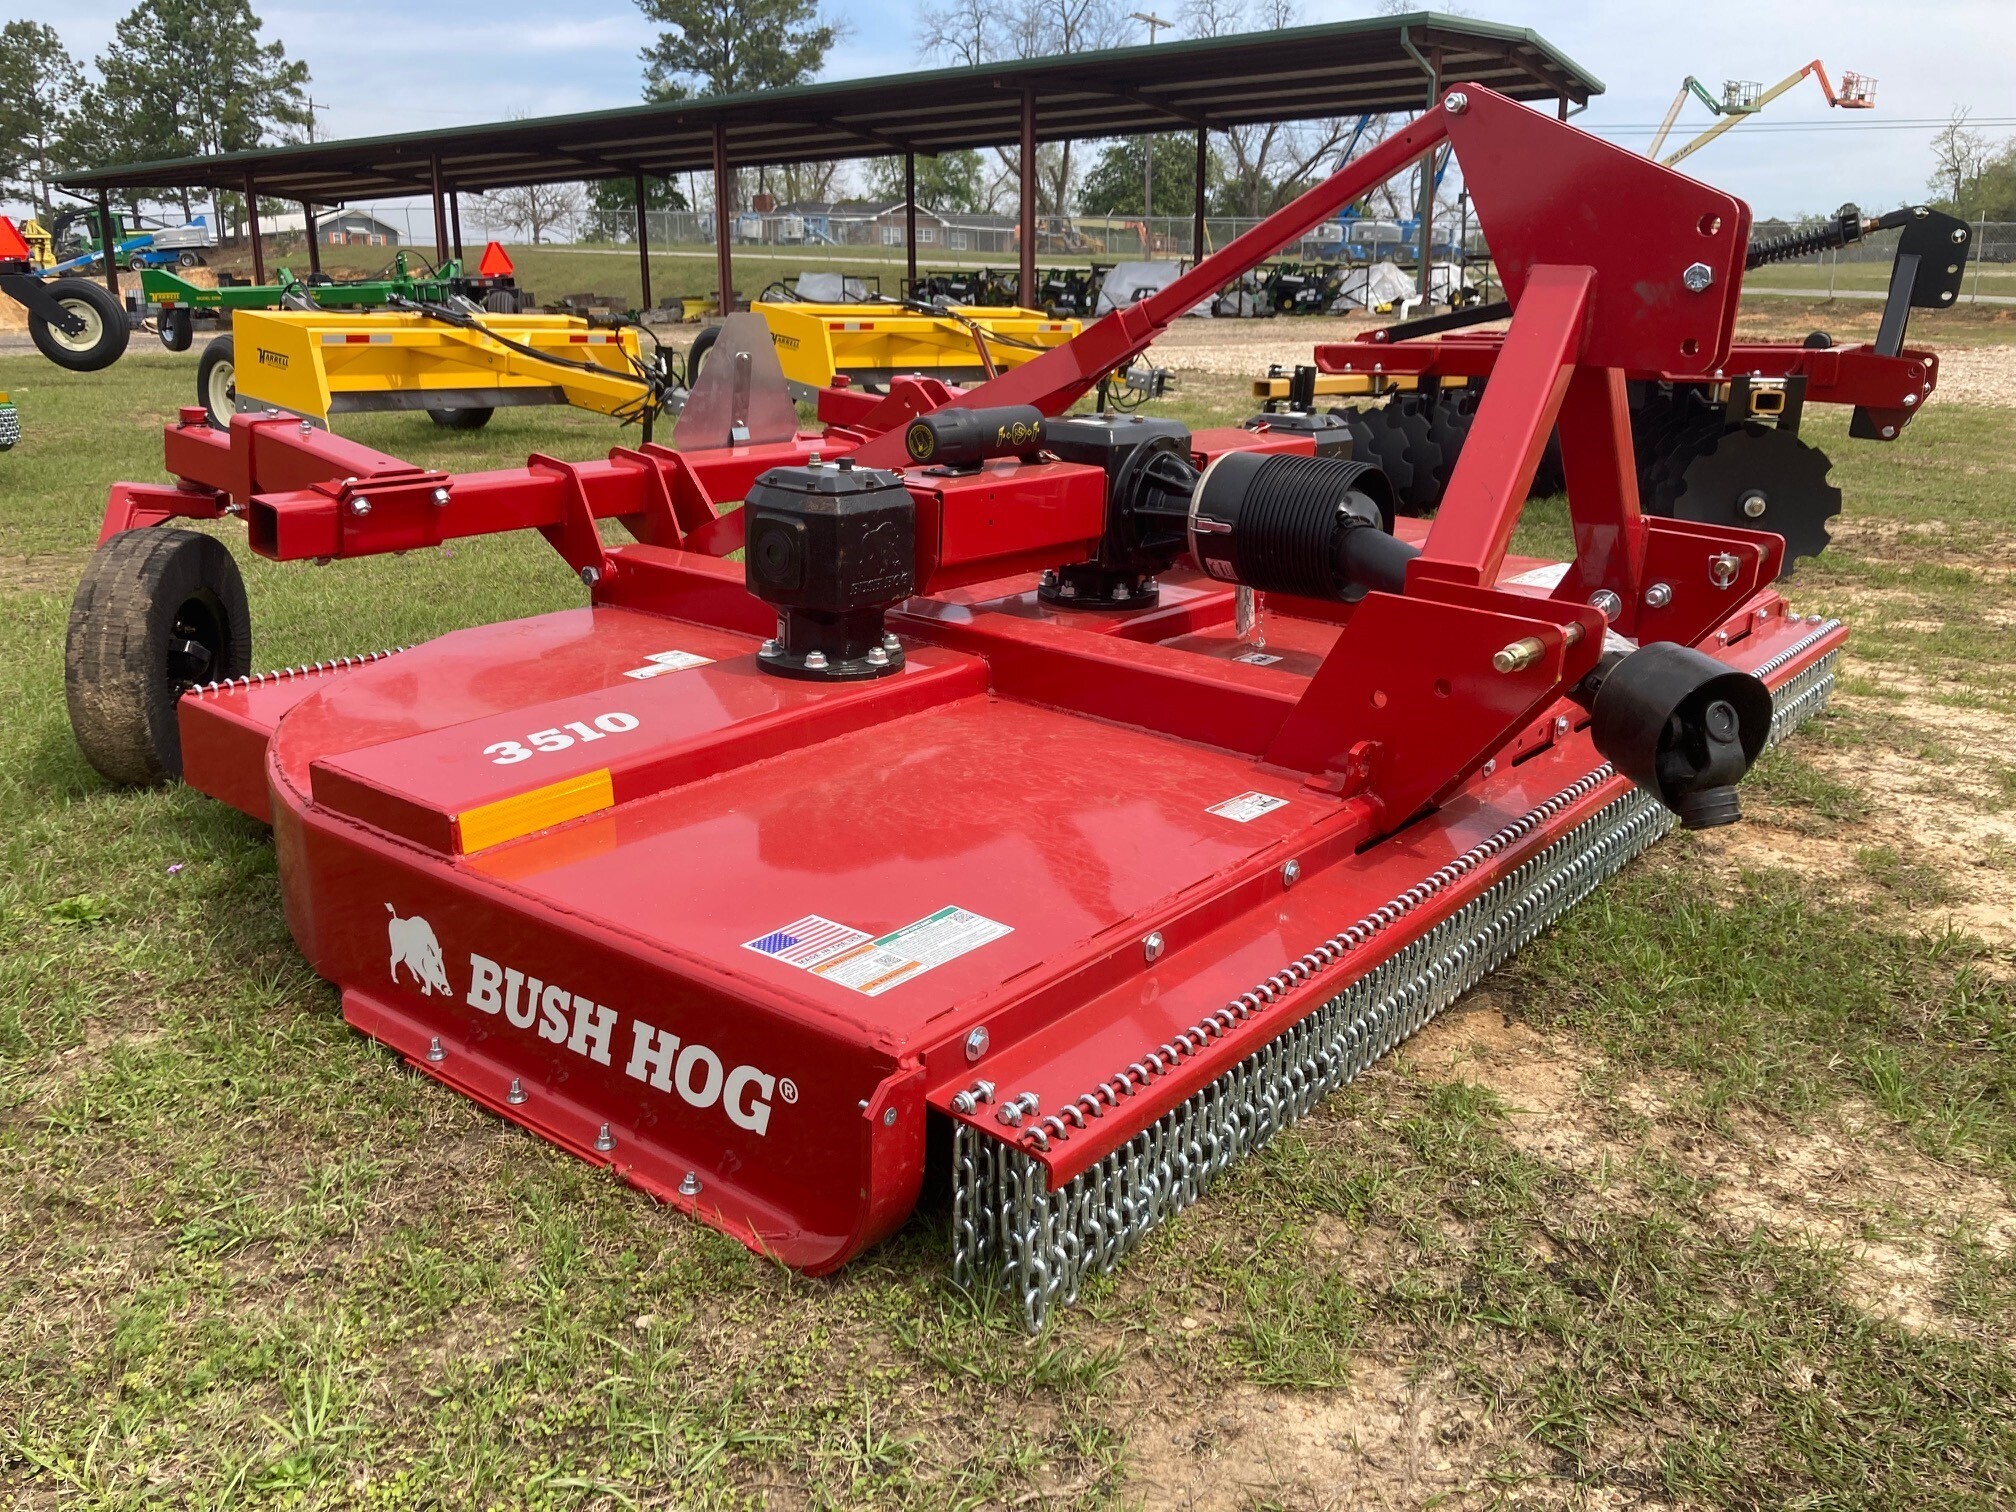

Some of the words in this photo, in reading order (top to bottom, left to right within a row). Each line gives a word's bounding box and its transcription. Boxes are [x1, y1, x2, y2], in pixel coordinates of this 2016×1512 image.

[256, 347, 289, 367] HARRELL
[483, 712, 640, 764] 3510
[797, 952, 821, 965] MADE
[831, 941, 846, 950] THE
[847, 934, 863, 942] USA
[880, 966, 912, 983] WARNING
[466, 952, 618, 1066] BUSH
